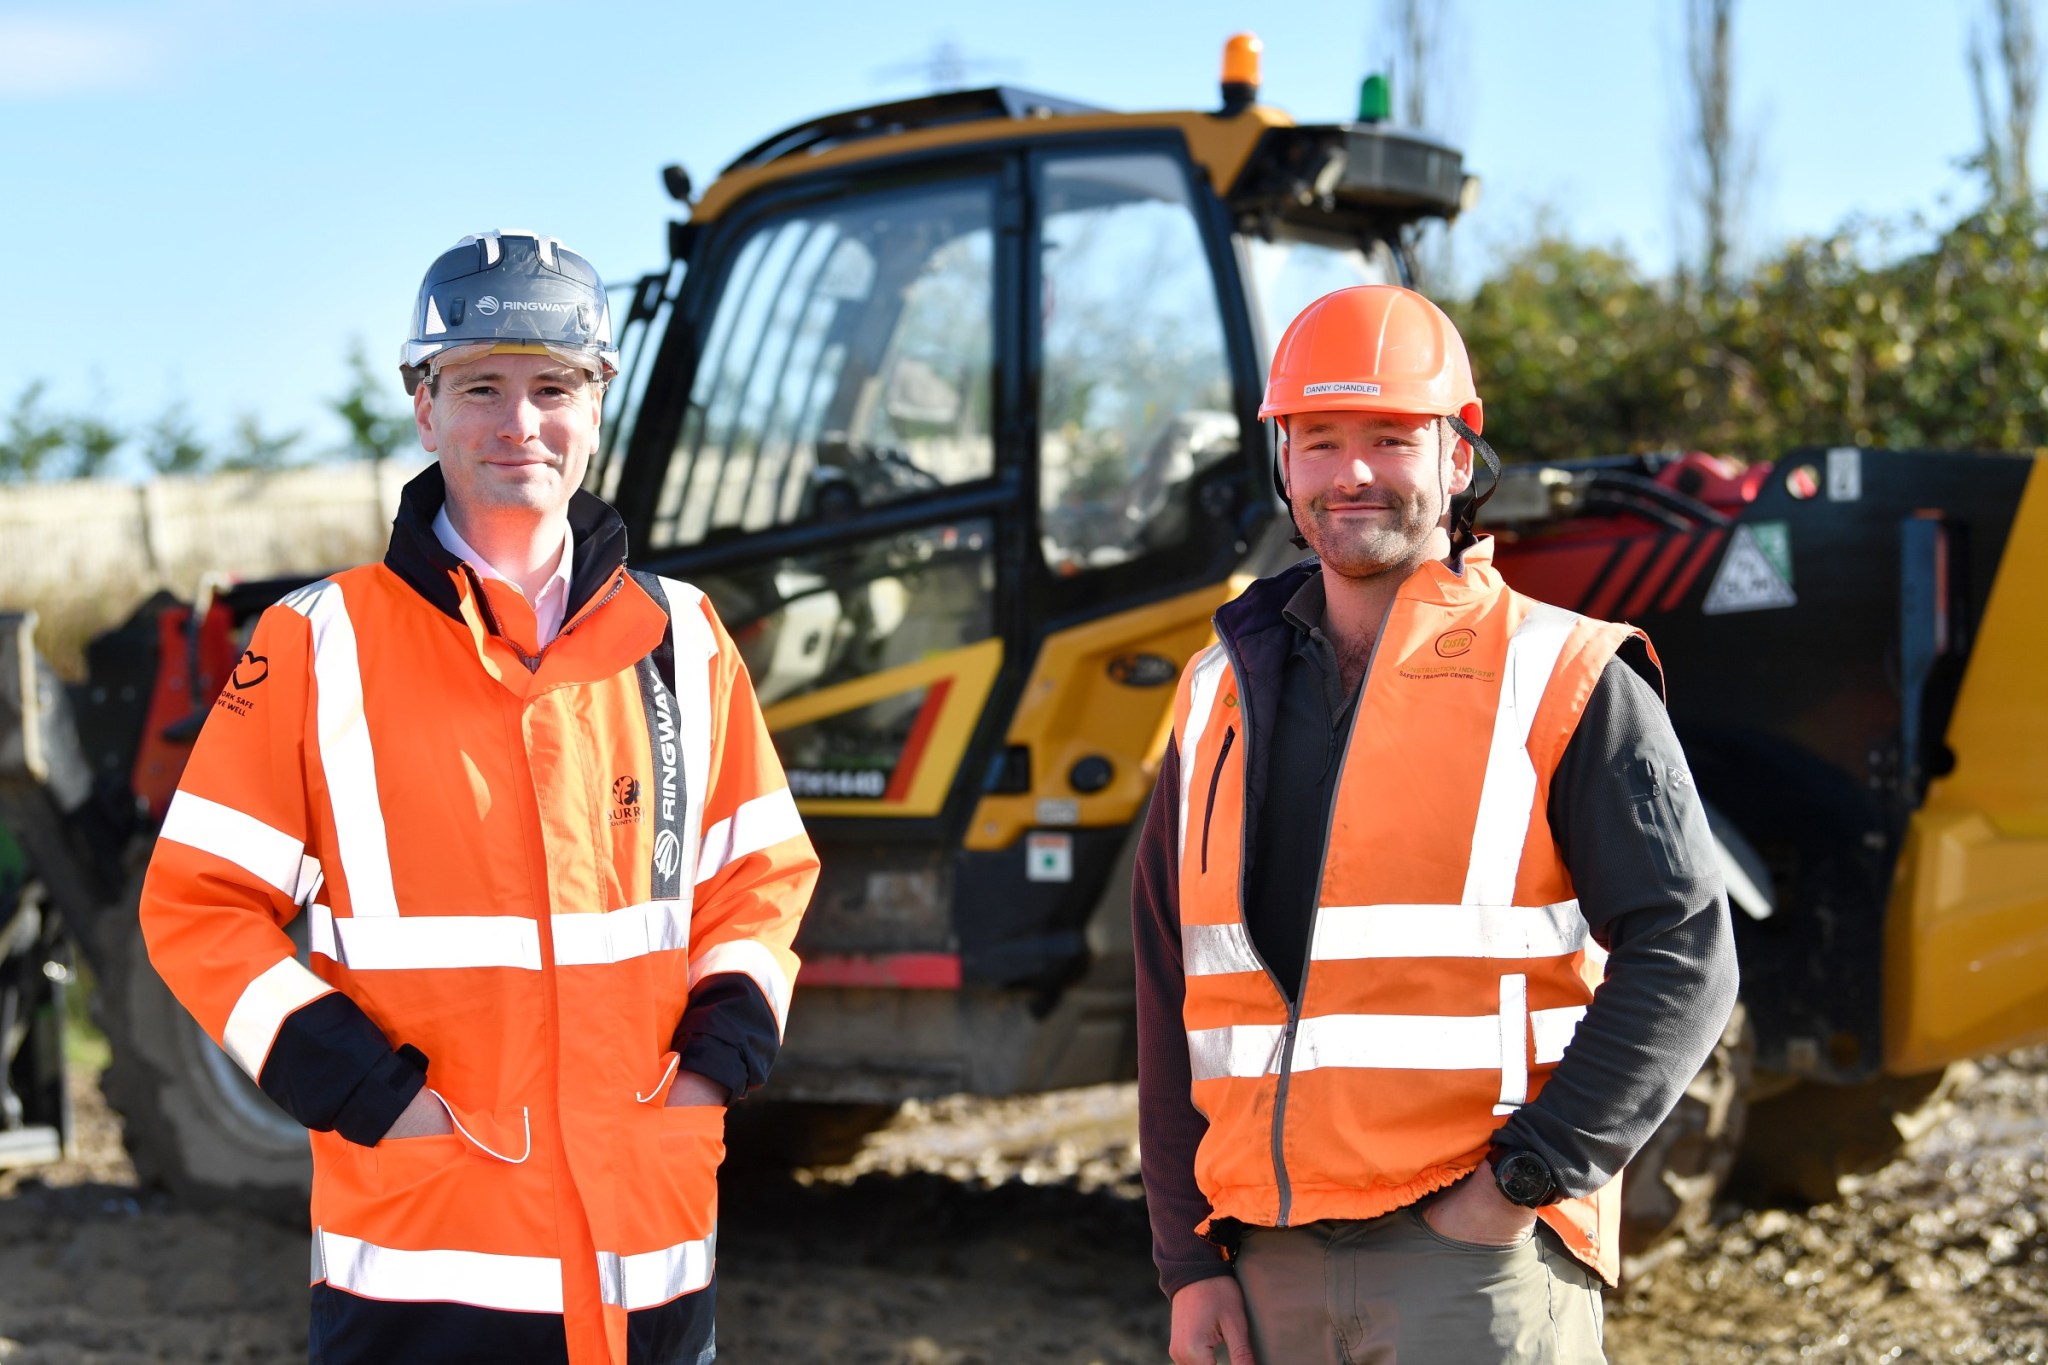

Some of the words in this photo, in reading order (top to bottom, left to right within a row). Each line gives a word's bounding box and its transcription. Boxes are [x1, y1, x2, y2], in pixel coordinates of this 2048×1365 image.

[502, 301, 572, 313] RINGWAY
[1306, 385, 1331, 394] DANNY
[1333, 384, 1378, 393] CHANDLER
[1399, 670, 1421, 679] SAFETY
[1422, 672, 1449, 680] TRAINING
[1450, 672, 1474, 680] CENTRE
[1401, 663, 1457, 674] CONSTRUCTION
[1458, 666, 1495, 678] INDUSTRY
[221, 690, 235, 701] ORK
[236, 696, 254, 710] SAFE
[227, 702, 246, 717] WELL
[650, 670, 676, 822] RINGWAY
